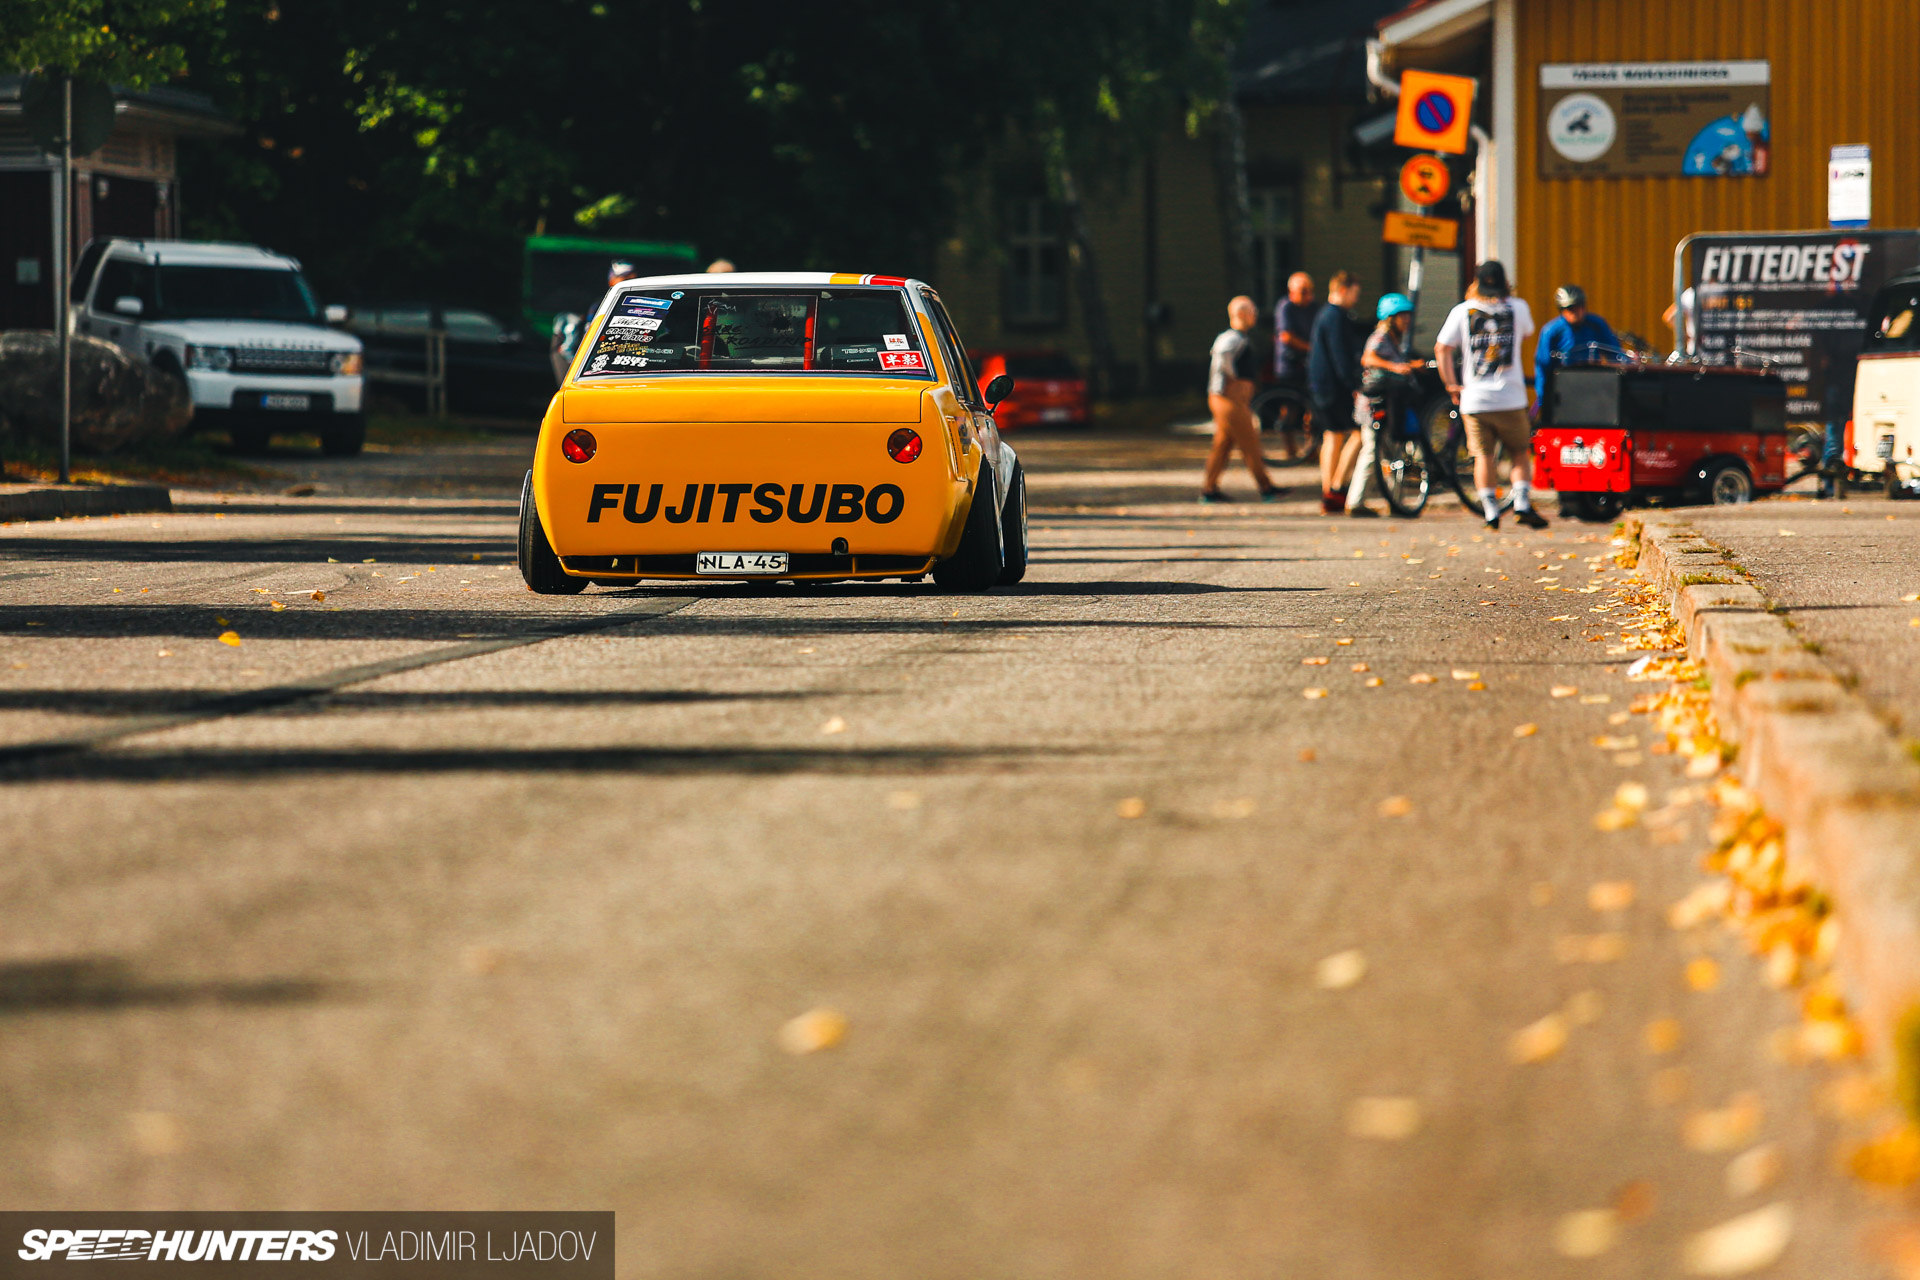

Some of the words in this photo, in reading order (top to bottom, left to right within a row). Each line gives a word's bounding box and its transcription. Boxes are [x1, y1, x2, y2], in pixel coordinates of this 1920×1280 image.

[1701, 244, 1870, 282] FITTEDFEST
[587, 483, 905, 524] FUJITSUBO
[703, 555, 782, 569] NLA-45
